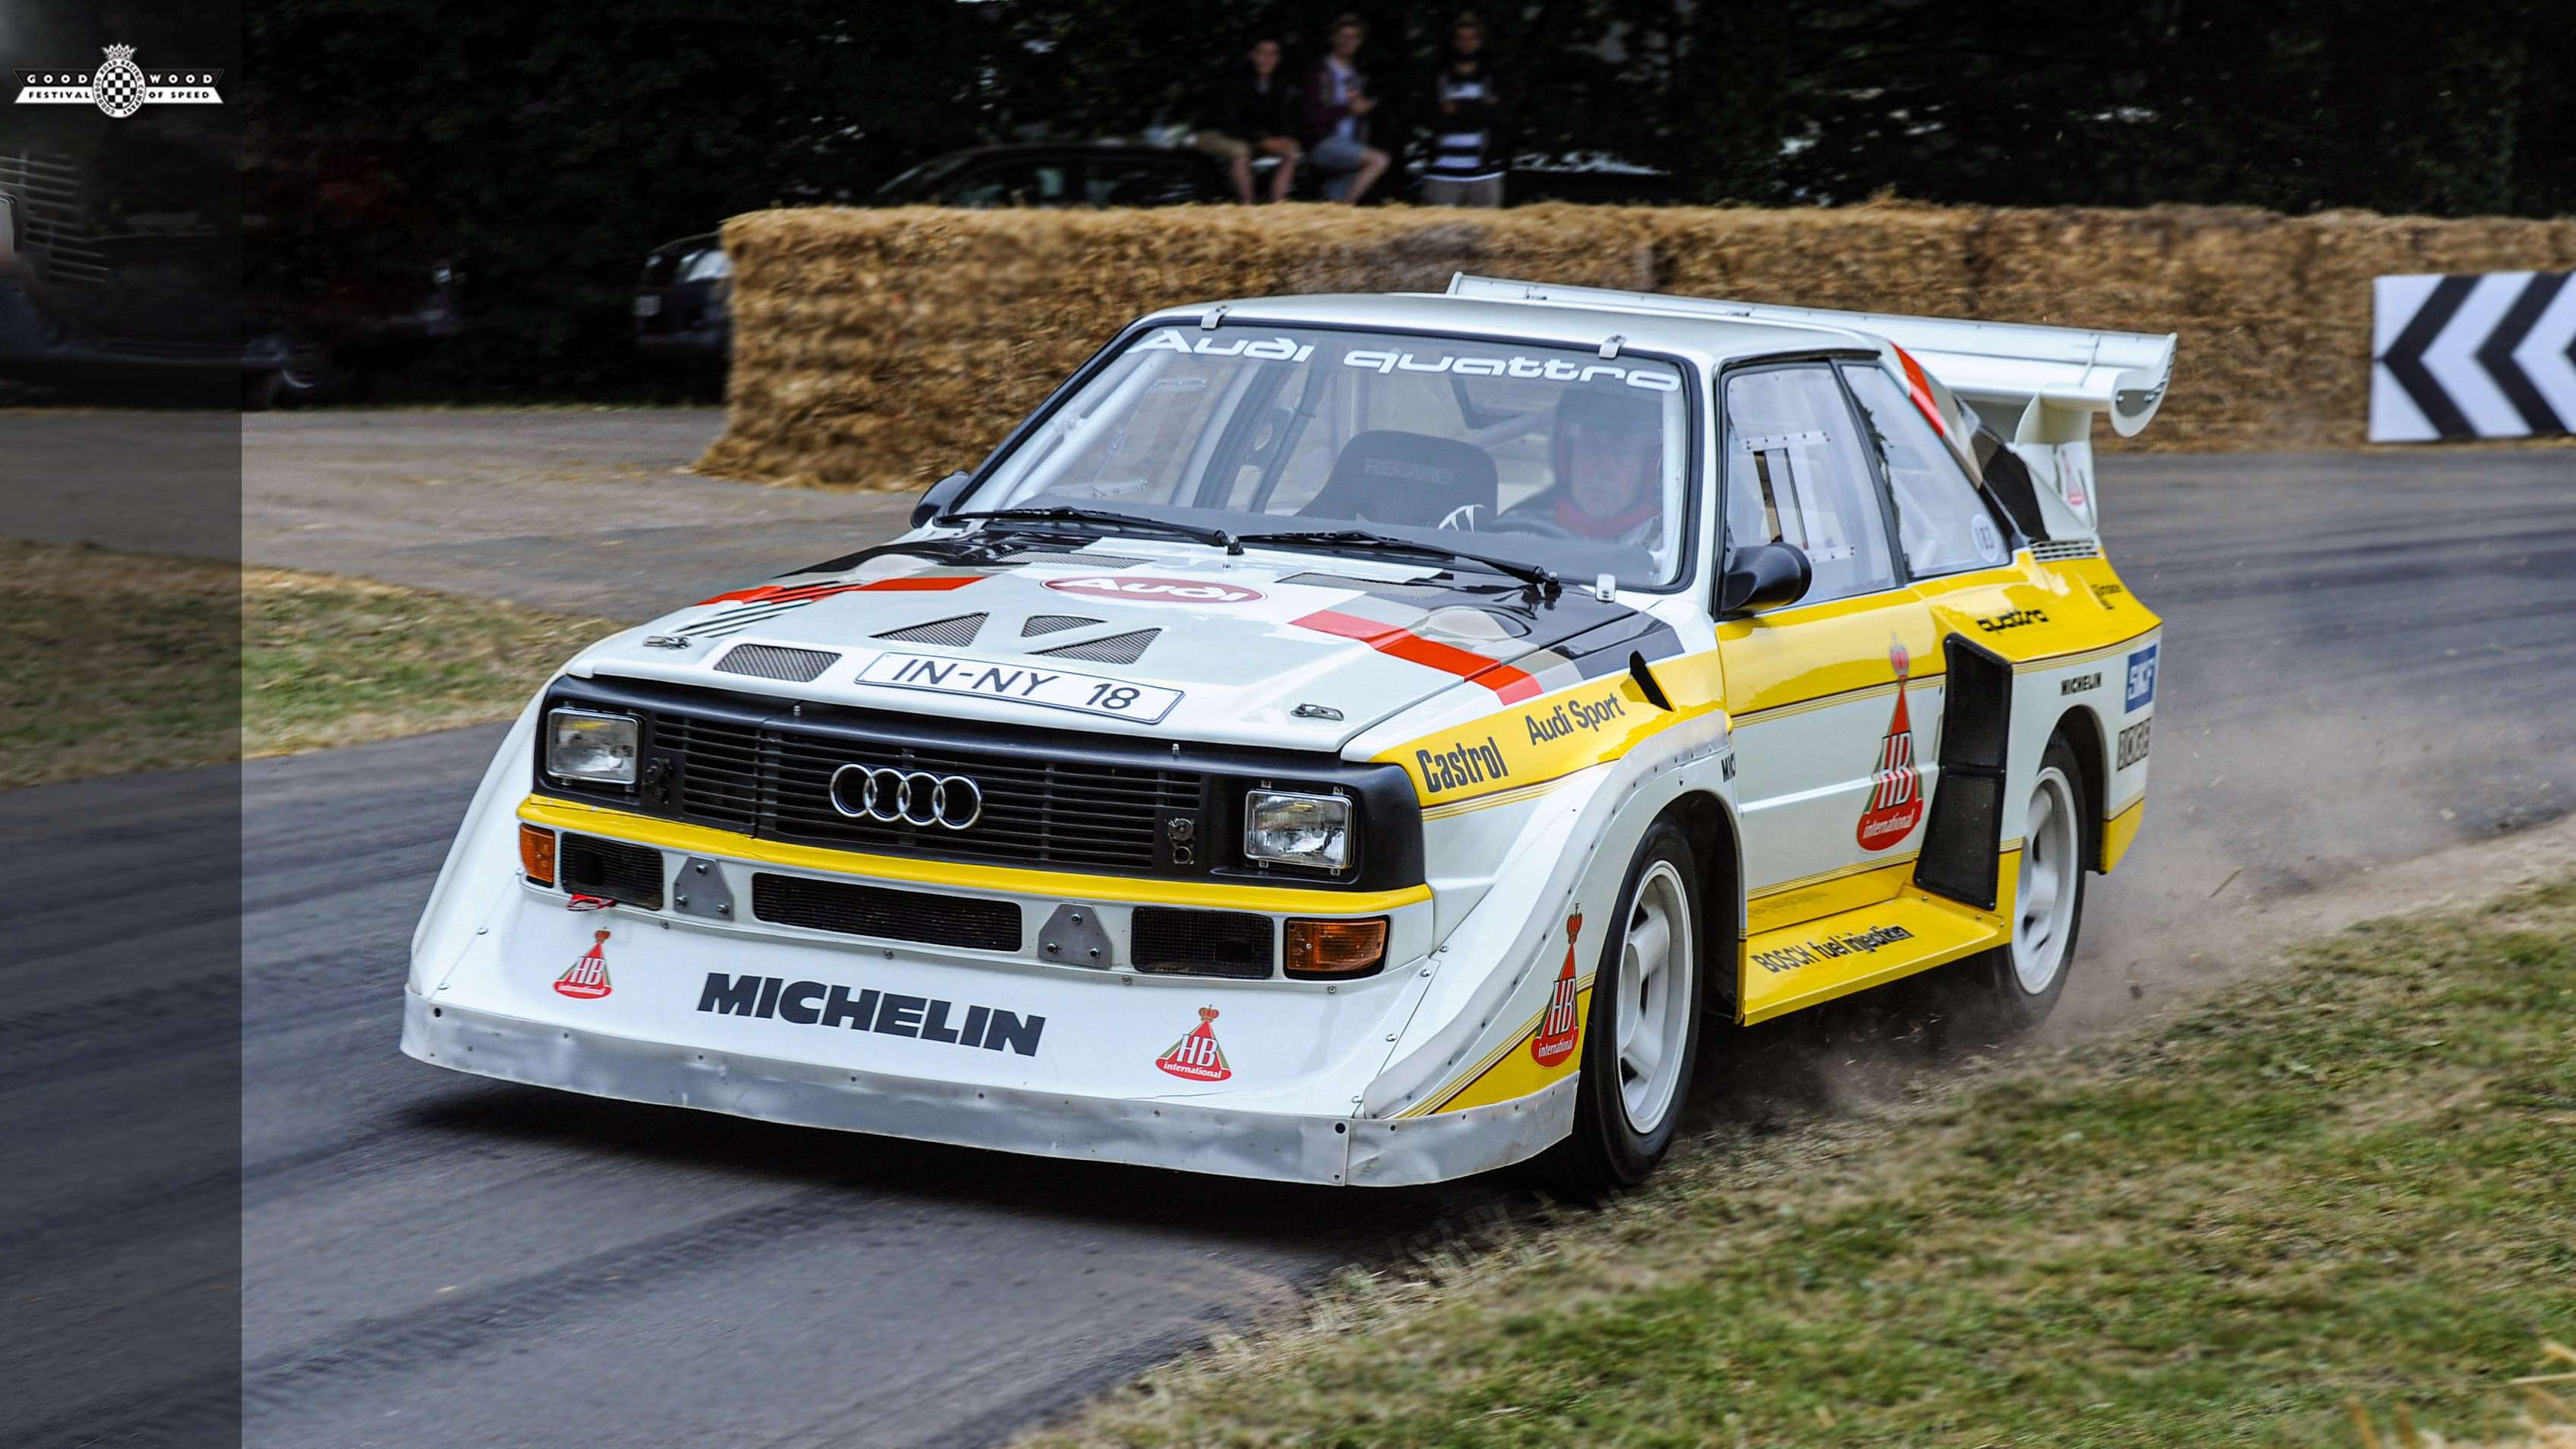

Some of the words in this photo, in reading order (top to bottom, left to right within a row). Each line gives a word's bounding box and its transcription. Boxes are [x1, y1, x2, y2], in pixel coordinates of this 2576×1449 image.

[1125, 329, 1315, 363] Audi
[1343, 348, 1680, 392] quattro
[1054, 578, 1248, 601] Audi
[892, 659, 1060, 696] IN-NY
[1085, 683, 1141, 710] 18
[1416, 736, 1509, 793] Castrol
[1524, 705, 1575, 746] Audi
[1568, 693, 1626, 732] Sport
[1878, 732, 1914, 810] HB
[569, 957, 604, 985] HB
[1750, 944, 1816, 973] BOSCH
[1807, 935, 1852, 962] fuel
[696, 972, 1046, 1057] MICHELIN
[1548, 978, 1576, 1036] HB
[1176, 1034, 1217, 1067] HB
[1538, 1034, 1575, 1057] international
[1163, 1061, 1223, 1078] international
